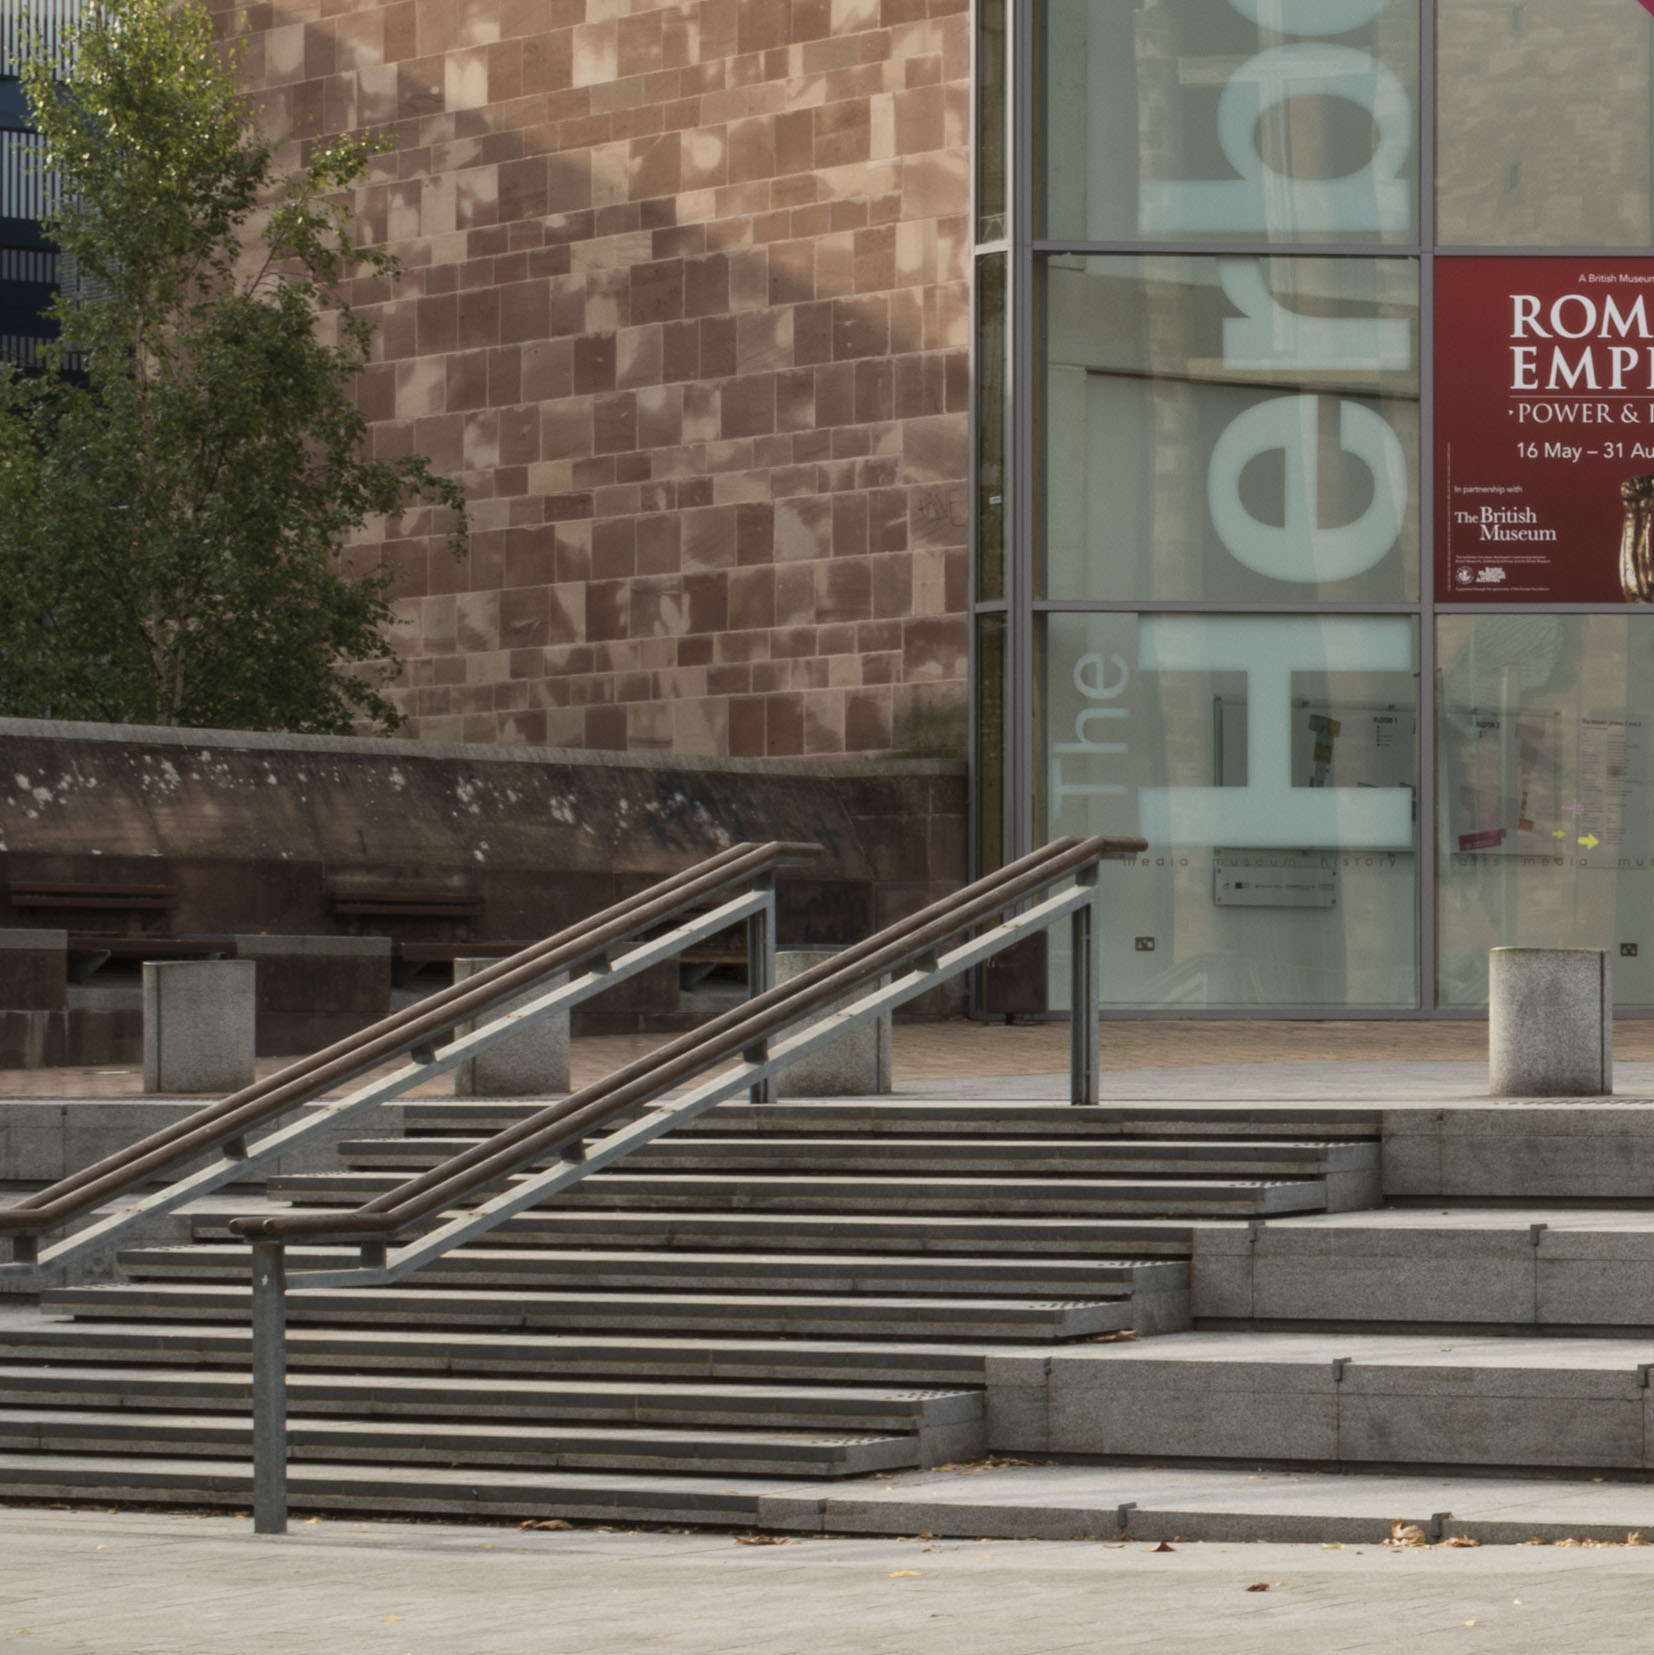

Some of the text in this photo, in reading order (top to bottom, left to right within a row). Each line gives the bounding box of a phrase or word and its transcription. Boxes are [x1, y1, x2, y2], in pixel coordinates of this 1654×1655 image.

[1578, 274, 1586, 283] A
[1588, 274, 1616, 283] British
[1518, 403, 1614, 424] POWER
[1620, 403, 1640, 424] &
[1517, 442, 1538, 458] 16
[1544, 442, 1582, 463] May
[1603, 442, 1623, 458] 31
[1454, 485, 1523, 495] In partnership with
[1454, 505, 1537, 524] The British
[1480, 524, 1557, 541] Museum
[1053, 652, 1129, 819] The
